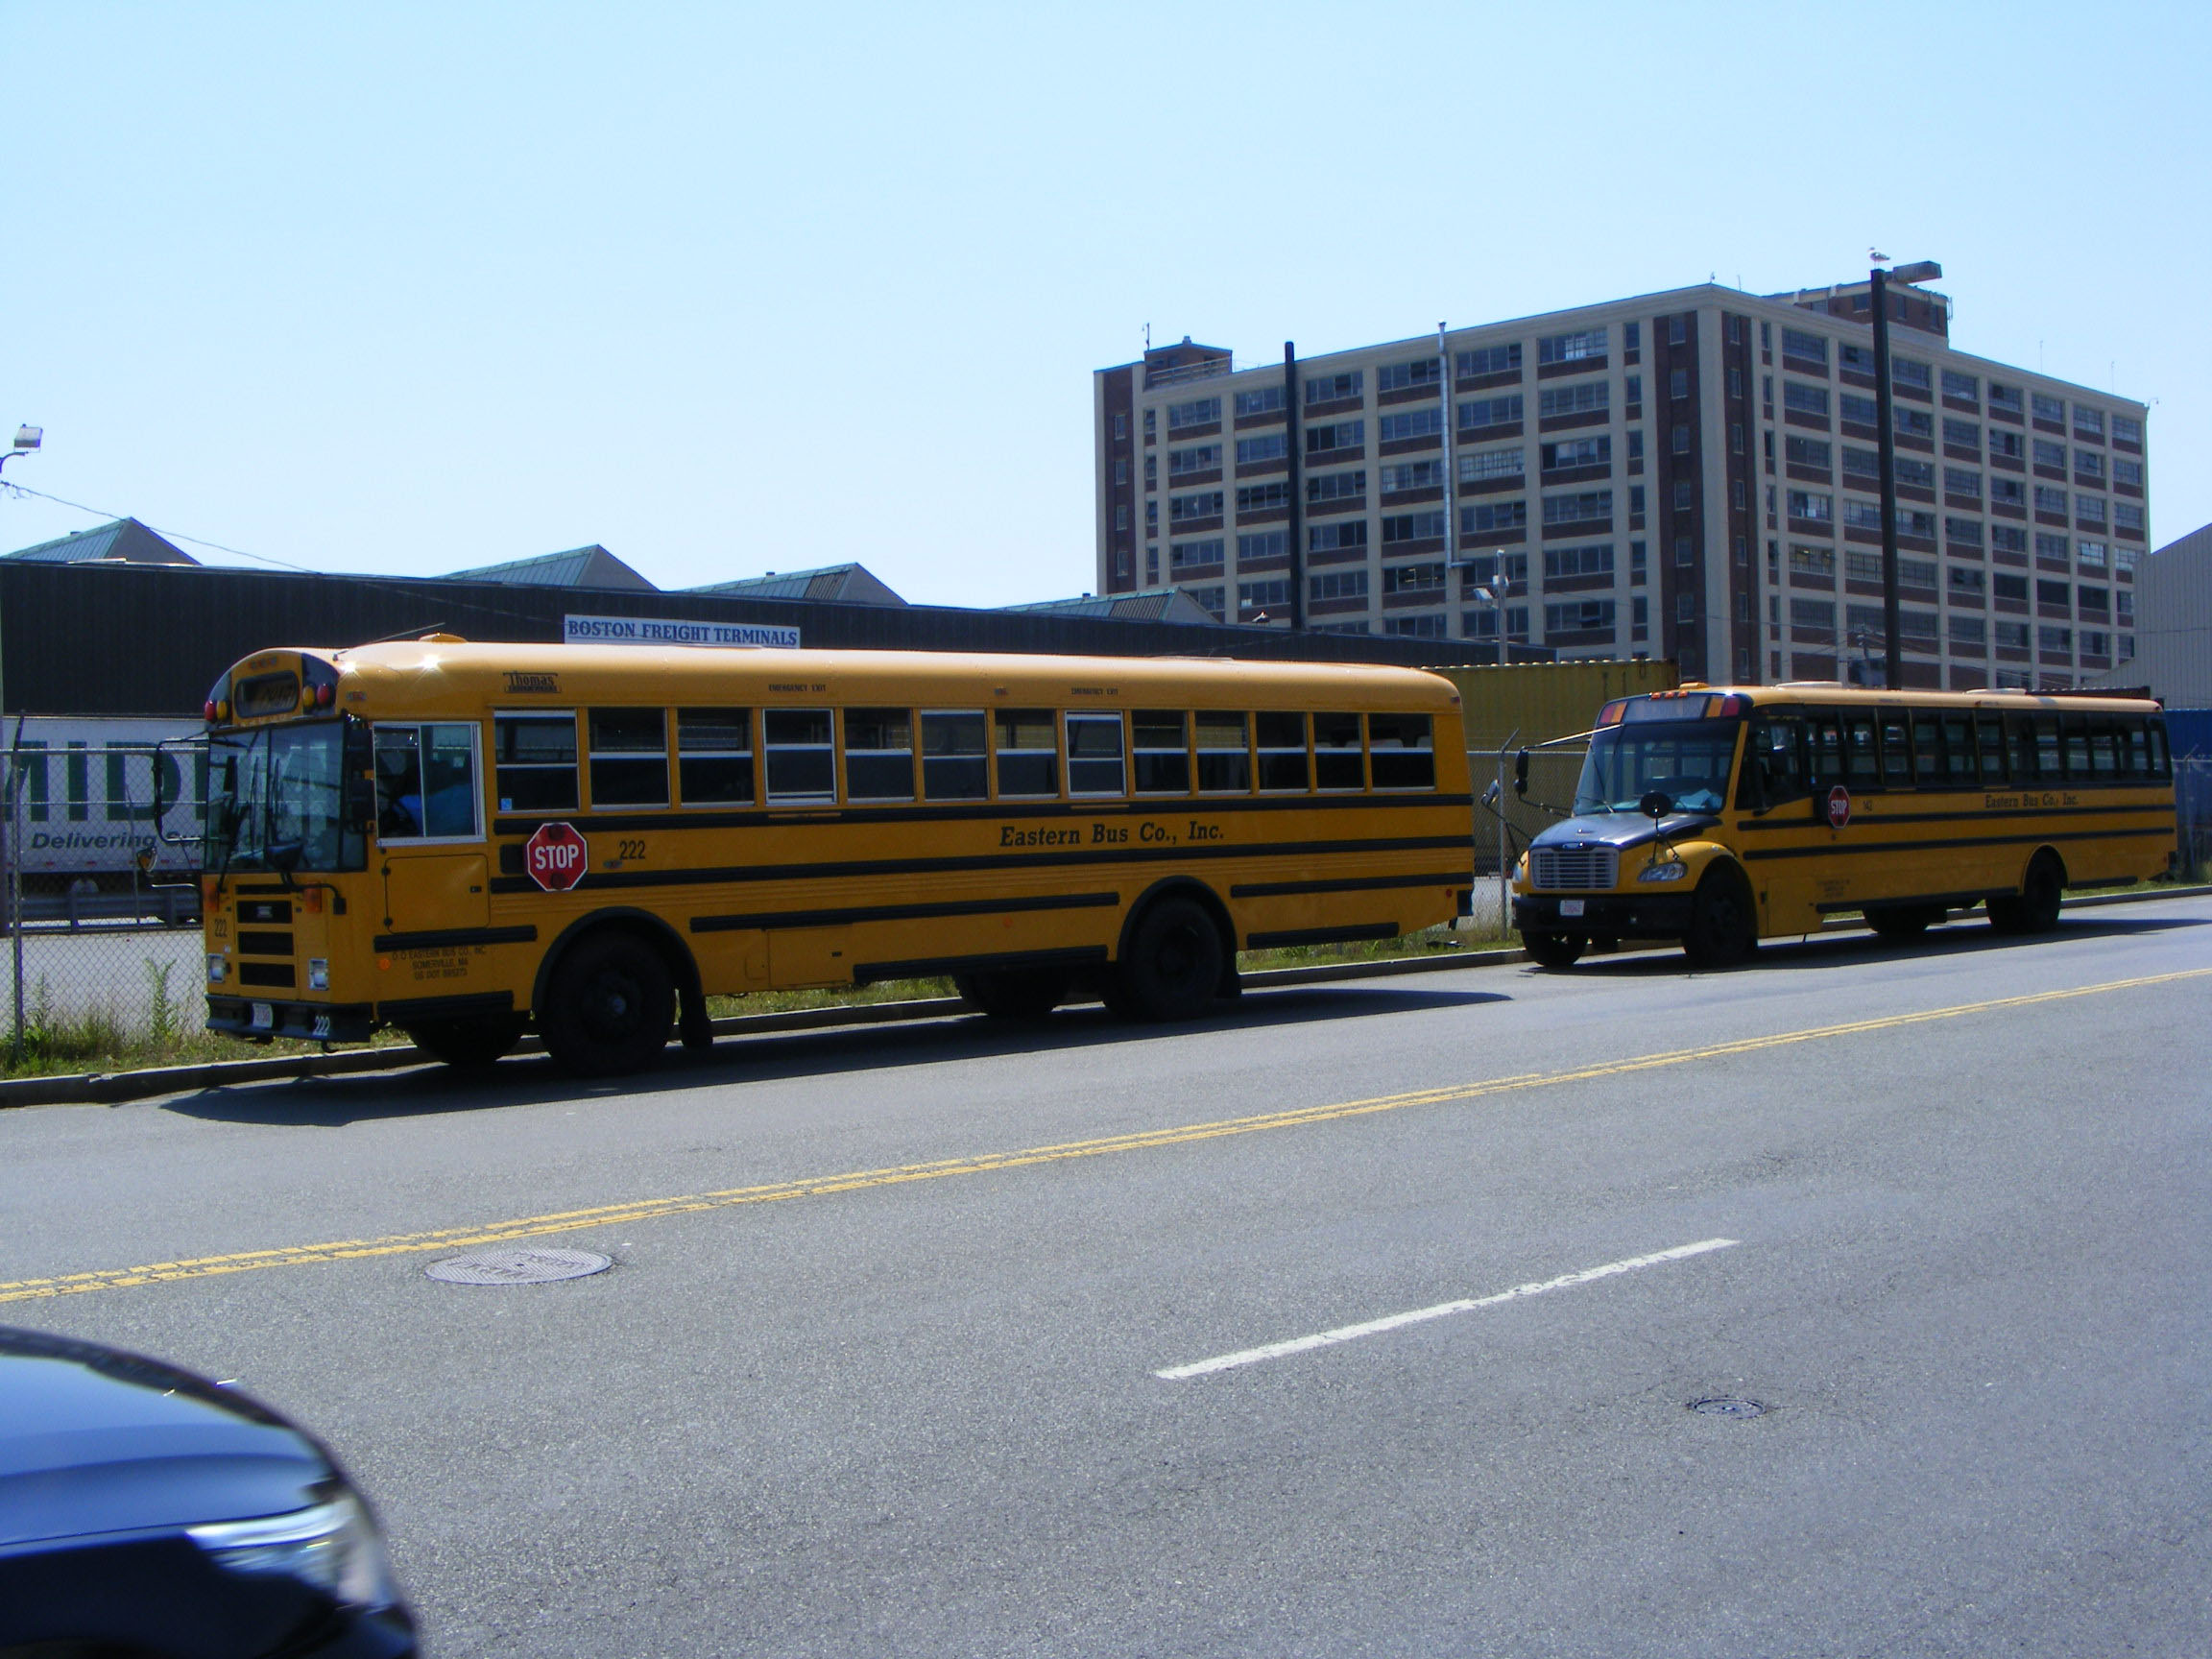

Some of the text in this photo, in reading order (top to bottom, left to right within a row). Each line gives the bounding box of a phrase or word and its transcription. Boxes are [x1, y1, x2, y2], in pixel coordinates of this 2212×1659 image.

[567, 620, 798, 646] BOSTON FREIGHT TERMINALS
[503, 671, 558, 685] Thomas
[1830, 799, 1847, 815] STOP
[1984, 793, 2019, 808] Eastern
[2023, 793, 2038, 807] Bus
[31, 831, 157, 852] Delivering
[998, 821, 1224, 847] Eastern Bus Co., Inc.
[535, 844, 580, 871] STOP
[618, 839, 646, 860] 222
[214, 918, 228, 938] 222
[312, 1015, 331, 1036] 222
